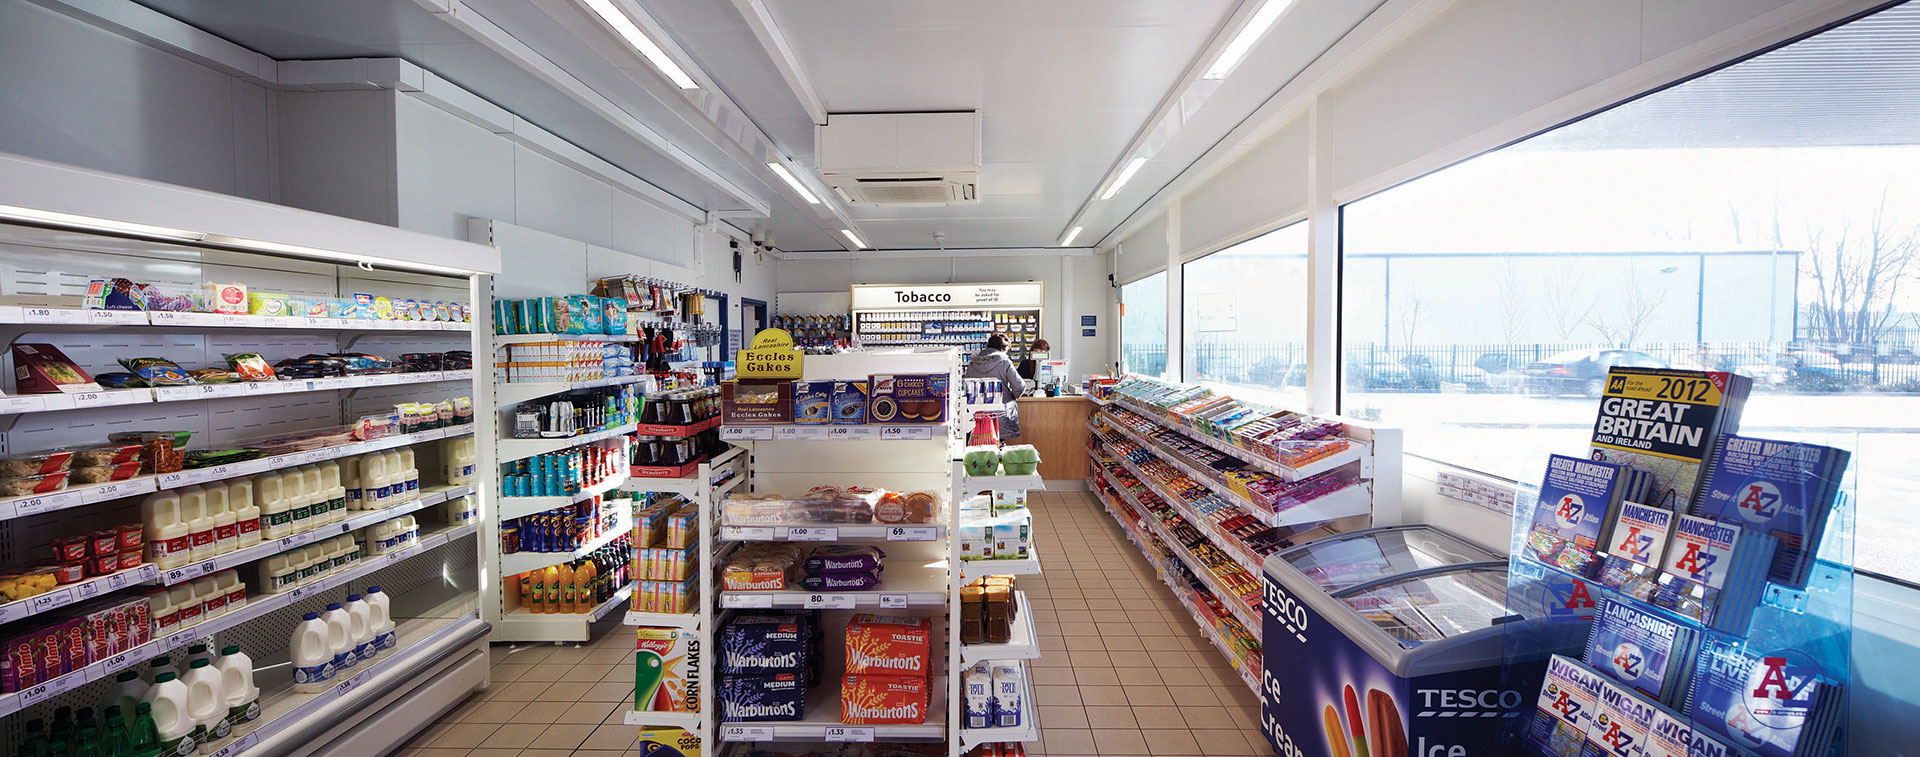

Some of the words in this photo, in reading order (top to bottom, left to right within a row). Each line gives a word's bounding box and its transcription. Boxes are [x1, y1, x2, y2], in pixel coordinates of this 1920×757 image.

[895, 291, 951, 303] Tobacco
[746, 352, 794, 361] Eccles
[747, 362, 791, 372] Cakes
[1611, 380, 1624, 390] AA
[1656, 378, 1710, 402] 2012
[1710, 373, 1724, 388] £1.99
[834, 396, 839, 405] 6
[898, 388, 924, 396] CUPCAKES
[1602, 398, 1691, 423] GREAT
[1595, 434, 1614, 444] AND
[1615, 438, 1652, 450] IRELAND
[1598, 416, 1704, 448] BRITAIN
[1724, 456, 1753, 465] ROCHDALE
[1726, 438, 1762, 454] GREATER
[1762, 442, 1822, 463] MANCHESTER
[1551, 457, 1575, 472] GREATER
[1574, 462, 1614, 480] MANCHESTER
[99, 486, 117, 494] £2.00
[20, 499, 42, 508] £2.00
[1540, 501, 1556, 512] Street
[1583, 513, 1599, 524] Atlas
[1711, 489, 1737, 502] Street
[1782, 503, 1804, 516] Atlas
[728, 512, 782, 524] Warburtons
[1622, 504, 1669, 527] MANCHESTER
[1678, 518, 1735, 544] MANCHESTER
[201, 562, 215, 574] NEW
[824, 559, 863, 569] Warburtons
[727, 578, 782, 590] Warburtons
[826, 576, 864, 587] Warburtons
[36, 597, 52, 605] £1.25
[1262, 576, 1308, 631] TESCO
[117, 612, 128, 642] Vimto
[138, 606, 148, 634] Vimto
[1604, 601, 1675, 639] LANCASHIRE
[70, 627, 84, 660] Vimto
[95, 619, 107, 650] Vimto
[641, 640, 667, 649] Kellogg's
[18, 643, 34, 678] Vimto
[46, 634, 61, 669] Vimto
[107, 656, 125, 666] £1.00
[687, 640, 700, 679] FLAKES
[726, 651, 796, 668] Warburtons
[851, 648, 921, 670] Warburtons
[1594, 644, 1613, 658] Street
[1644, 668, 1661, 681] Atlas
[1261, 655, 1281, 704] Ice
[1552, 658, 1604, 693] WIGAN
[24, 686, 46, 699] £1.00
[686, 681, 698, 710] CORN
[1417, 689, 1522, 709] TESCO
[1542, 689, 1557, 701] Street
[725, 700, 795, 718] Warburtons
[848, 700, 918, 719] Warburtons
[1603, 686, 1656, 723] WIGAN
[1592, 720, 1607, 733] Street
[1700, 701, 1726, 720] Street
[1772, 735, 1792, 751] Atlas
[1418, 737, 1466, 757] Ice
[1656, 719, 1722, 757] WIGAN
